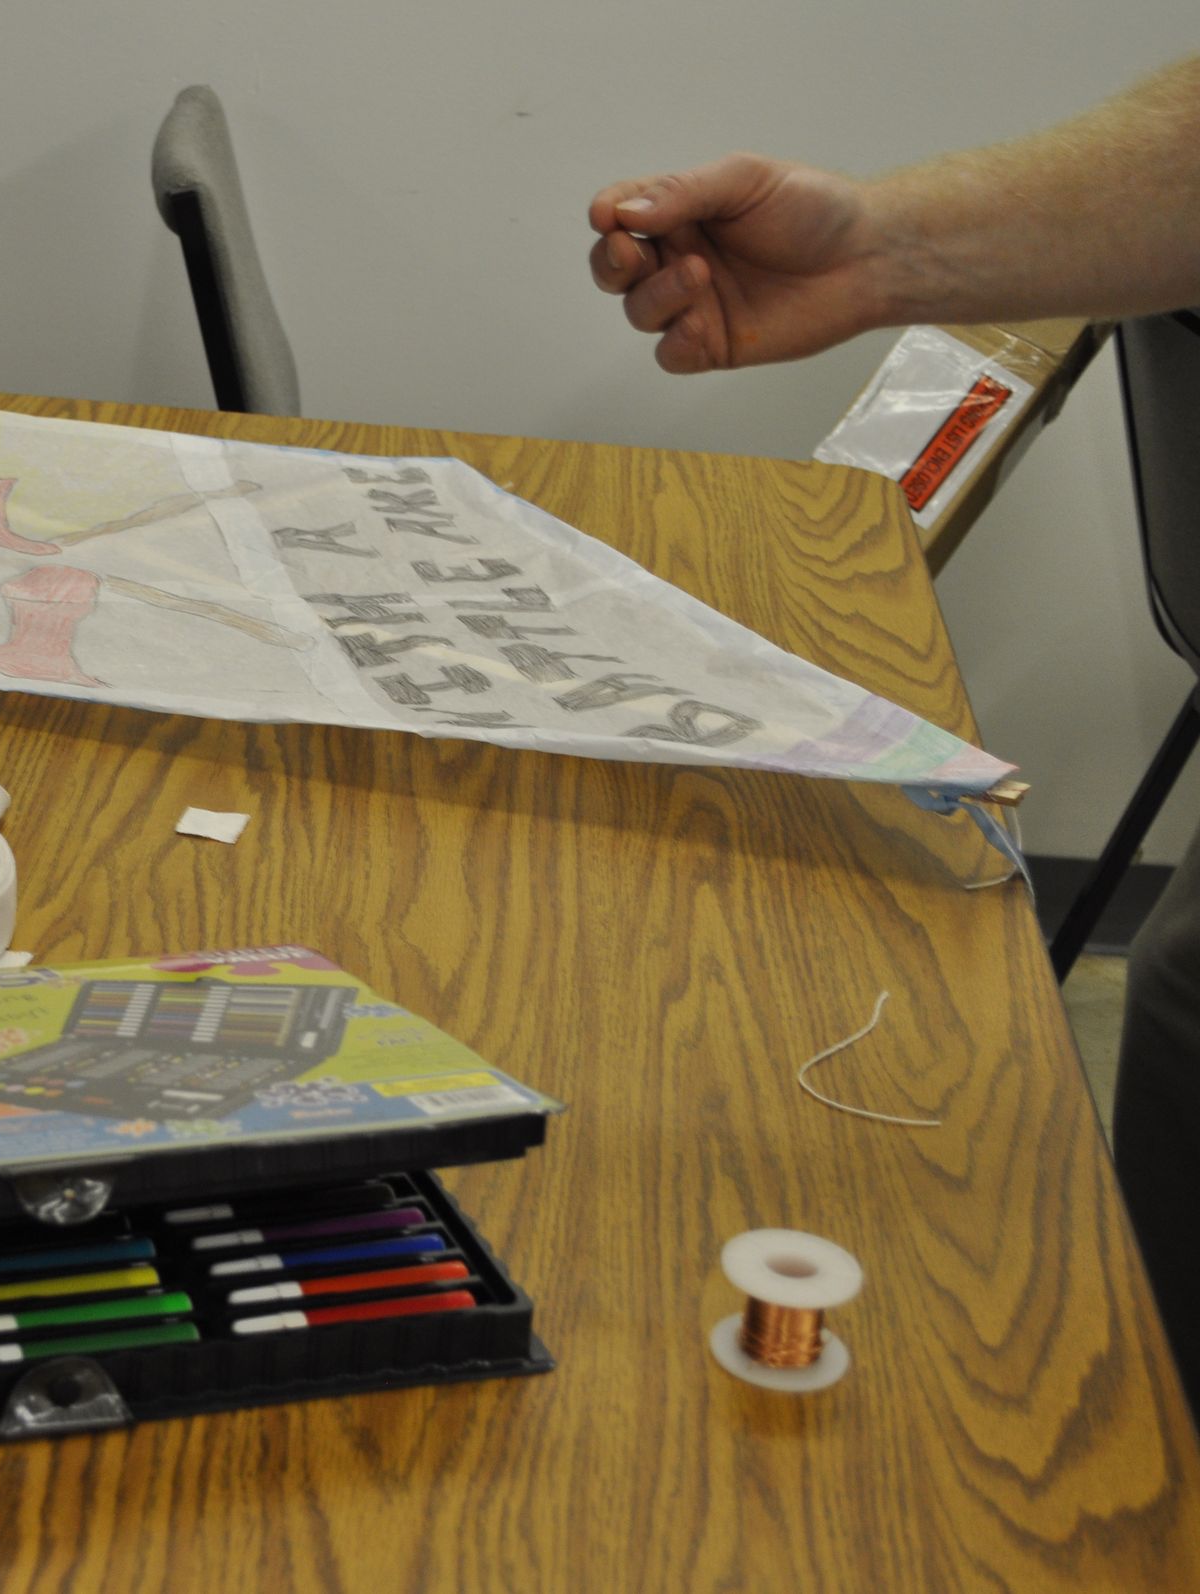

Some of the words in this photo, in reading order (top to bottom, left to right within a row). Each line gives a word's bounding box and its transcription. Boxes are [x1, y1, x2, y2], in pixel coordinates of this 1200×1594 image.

[270, 520, 380, 559] A
[341, 466, 481, 546] AXE
[410, 557, 765, 747] BATTLE
